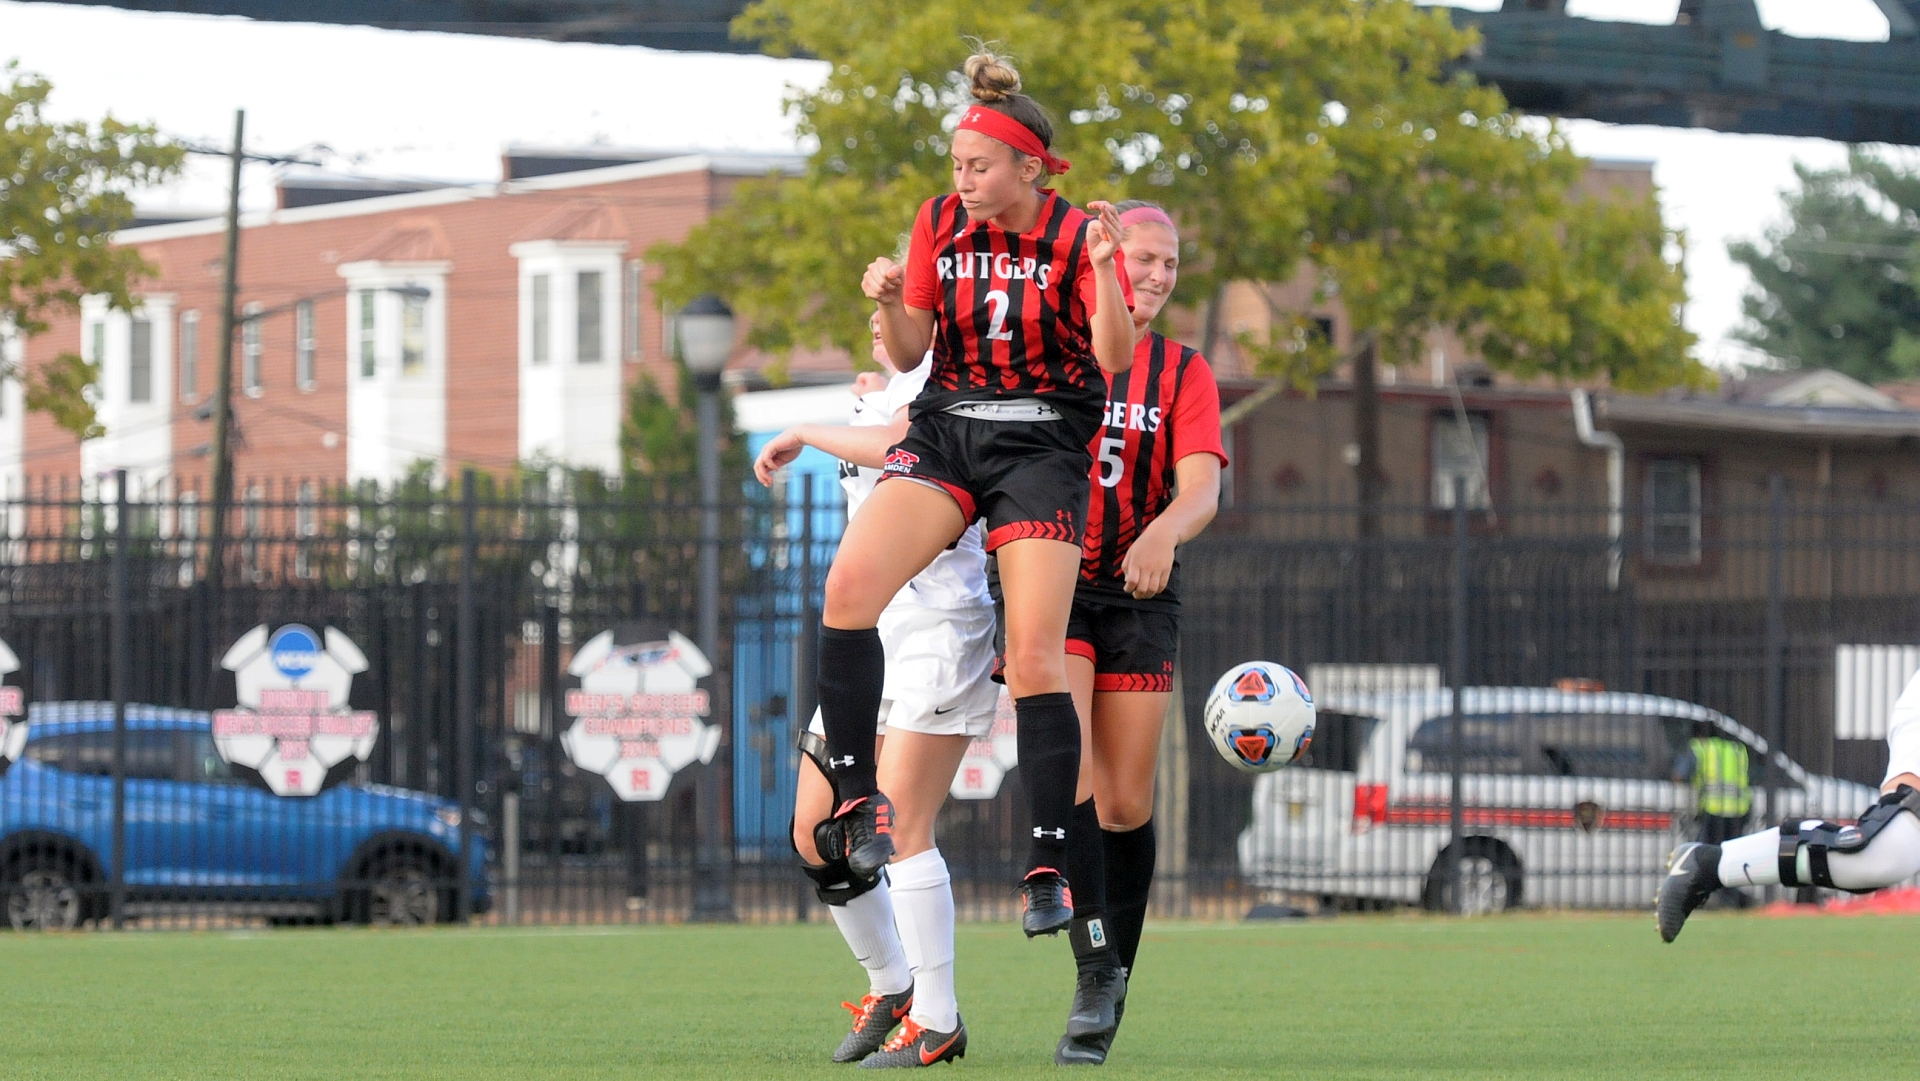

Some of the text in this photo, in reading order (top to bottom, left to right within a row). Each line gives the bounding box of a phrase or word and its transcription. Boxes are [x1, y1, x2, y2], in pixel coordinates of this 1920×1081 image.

[936, 252, 1052, 290] RUTGERS
[983, 289, 1013, 341] 2
[1098, 437, 1126, 488] 5
[630, 692, 708, 714] SOCCER
[584, 716, 692, 736] CHAMPIONS
